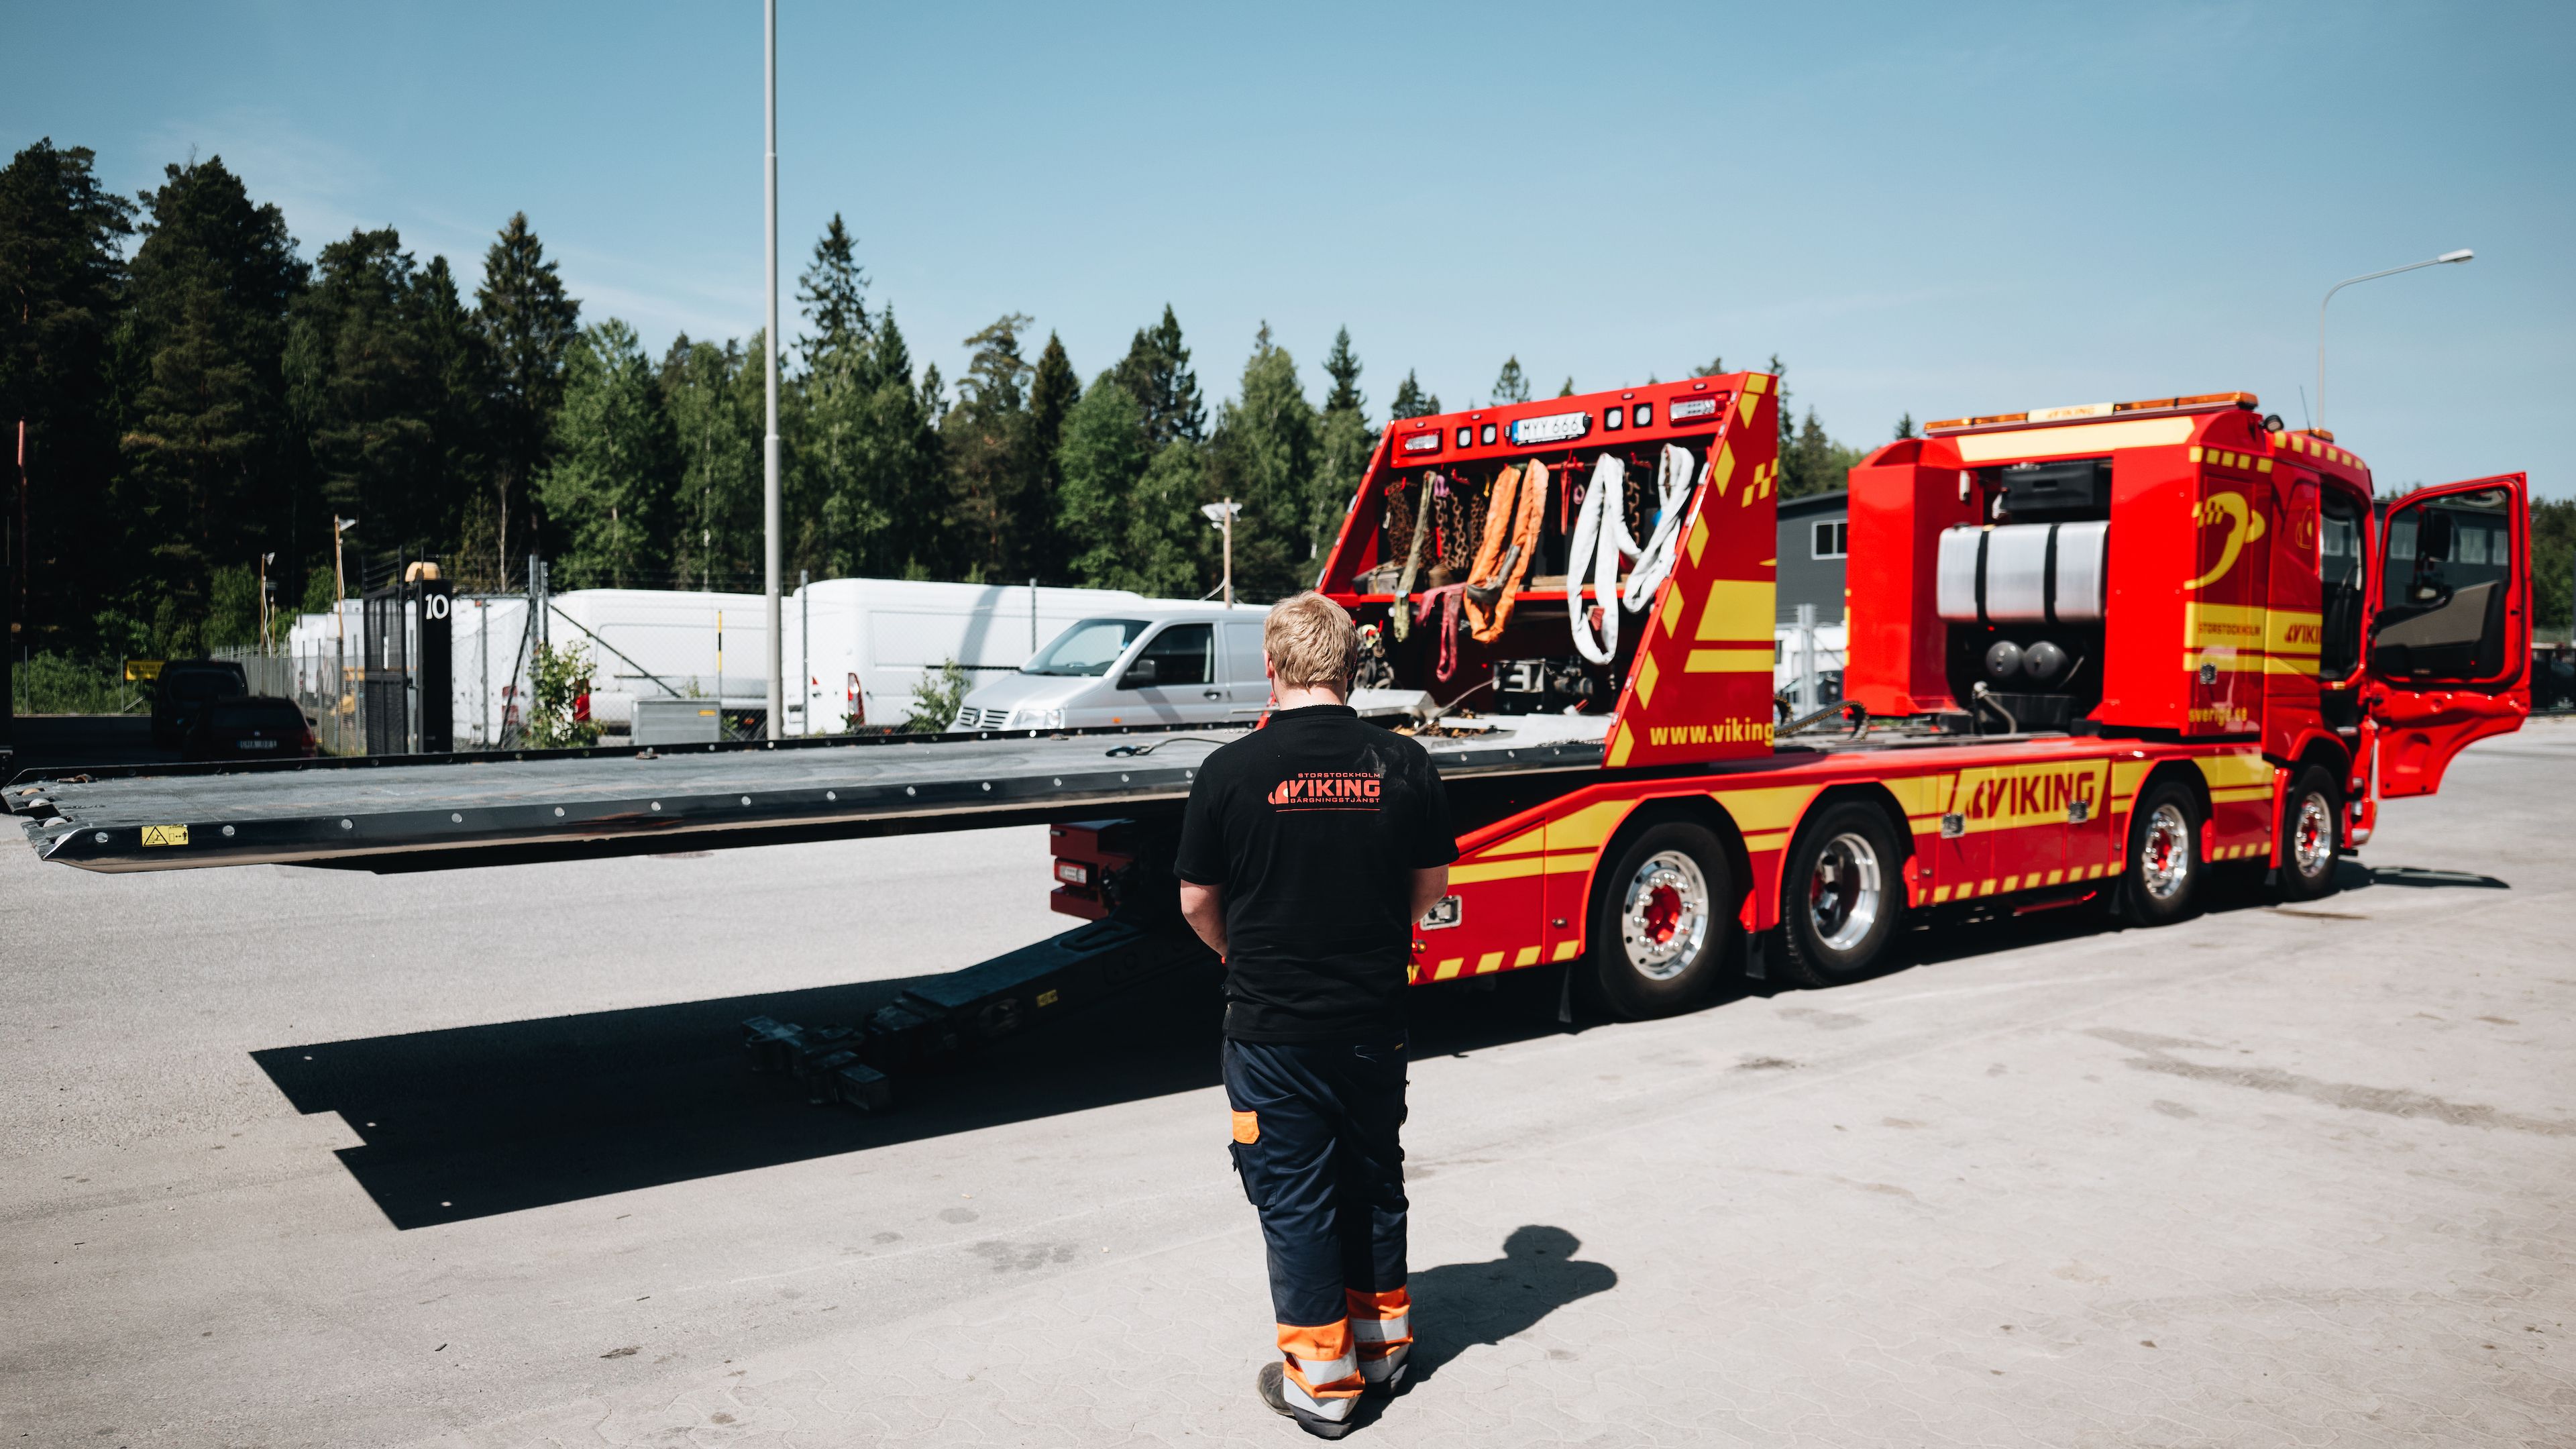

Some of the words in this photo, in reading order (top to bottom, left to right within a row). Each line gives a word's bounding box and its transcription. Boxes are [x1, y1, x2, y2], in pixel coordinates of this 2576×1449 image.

[1523, 419, 1548, 440] MYY
[1553, 416, 1578, 433] 666
[425, 594, 449, 619] 10
[2293, 625, 2323, 645] VIKI
[1650, 716, 1774, 747] www.viking
[1289, 779, 1381, 797] VIKING
[1987, 771, 2095, 819] VIKING
